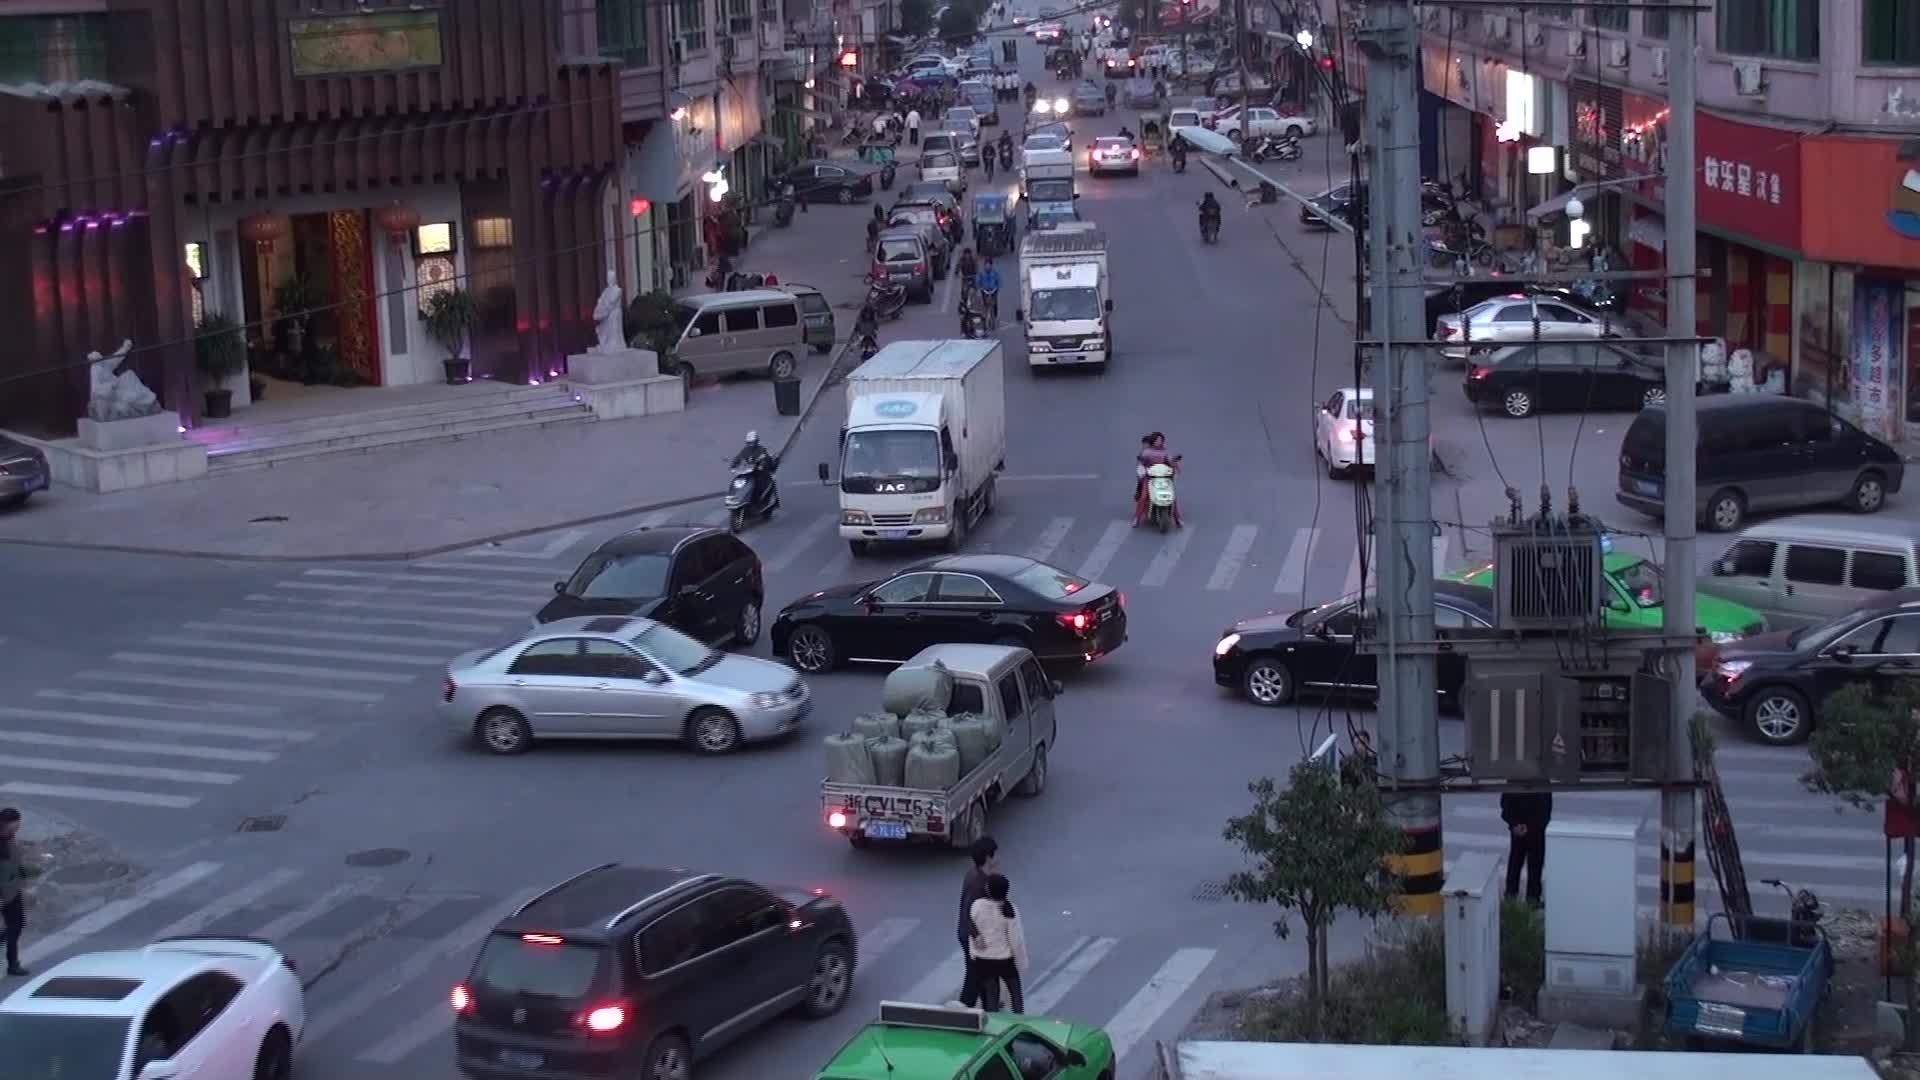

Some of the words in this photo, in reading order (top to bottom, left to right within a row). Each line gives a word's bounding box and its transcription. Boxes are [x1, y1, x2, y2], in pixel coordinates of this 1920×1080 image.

[1704, 155, 1781, 204] 快乐星汉堡
[875, 483, 906, 493] JAC
